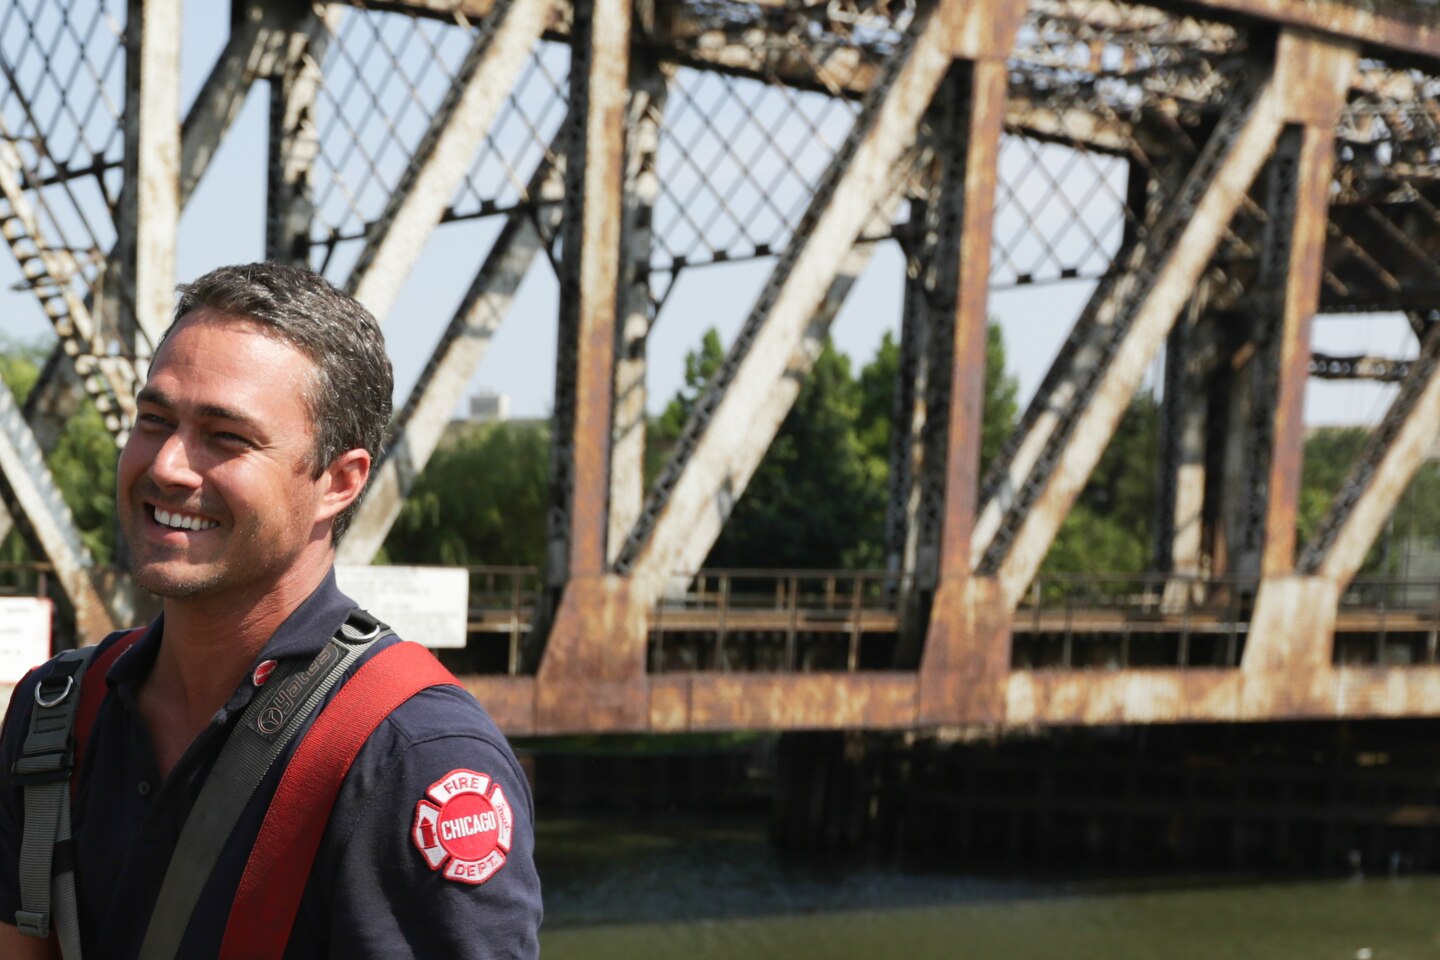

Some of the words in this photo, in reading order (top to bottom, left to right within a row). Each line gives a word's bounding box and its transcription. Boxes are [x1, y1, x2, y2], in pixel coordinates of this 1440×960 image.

[443, 777, 480, 795] FIRE
[441, 811, 496, 841] CHICAGO
[454, 856, 498, 877] DEPT
